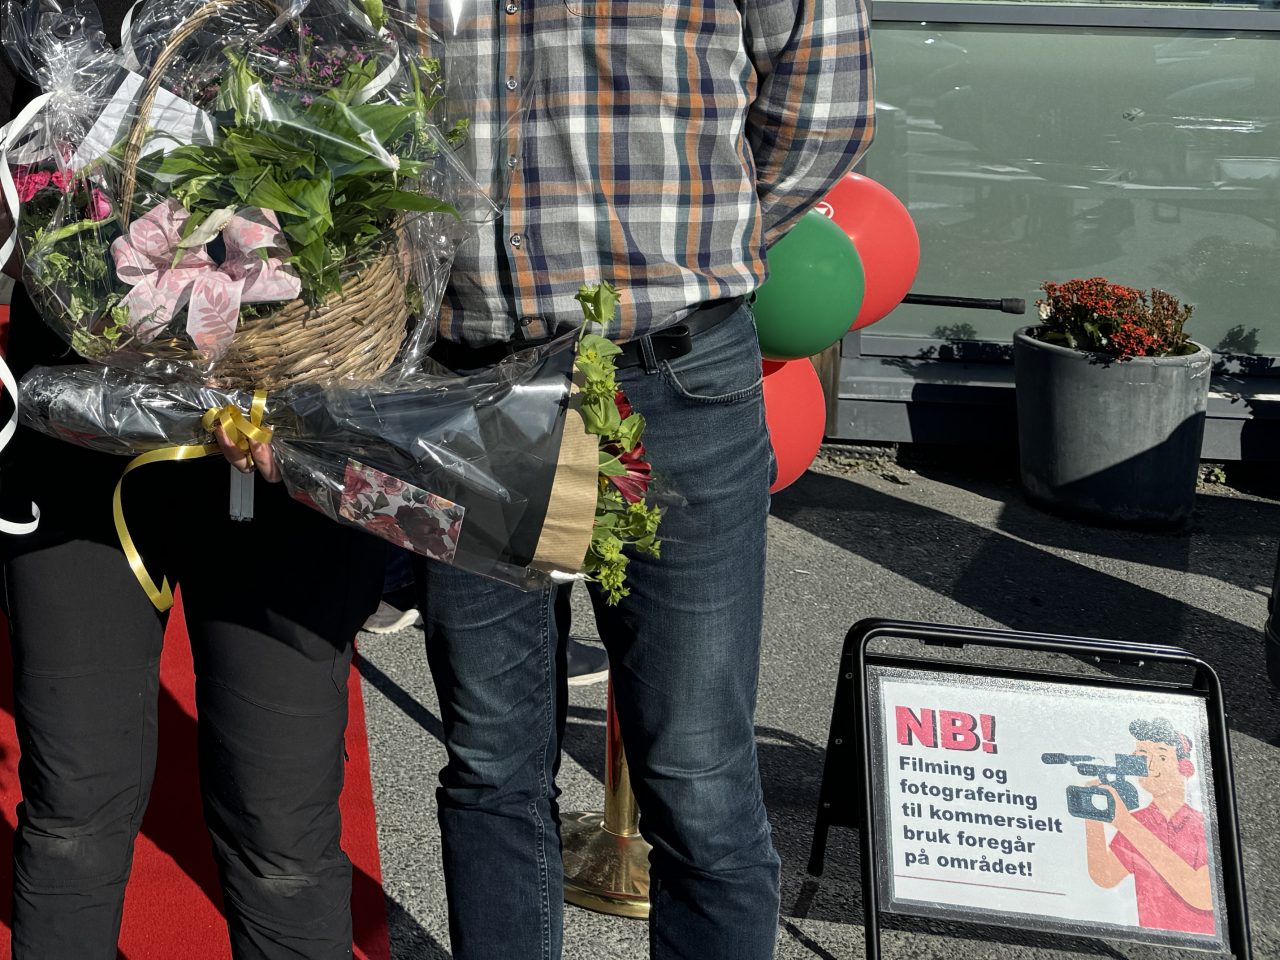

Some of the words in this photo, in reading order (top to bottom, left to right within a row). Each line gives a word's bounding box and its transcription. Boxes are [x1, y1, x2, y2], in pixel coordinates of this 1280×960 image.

[895, 705, 998, 754] NB!
[899, 756, 975, 781] Filming
[982, 767, 1008, 784] og
[900, 779, 1038, 810] fotografering
[902, 802, 923, 818] til
[929, 804, 1063, 833] kommersielt
[903, 825, 951, 844] bruk
[957, 831, 1036, 854] foregår
[905, 848, 930, 866] på
[937, 855, 1033, 876] området!
